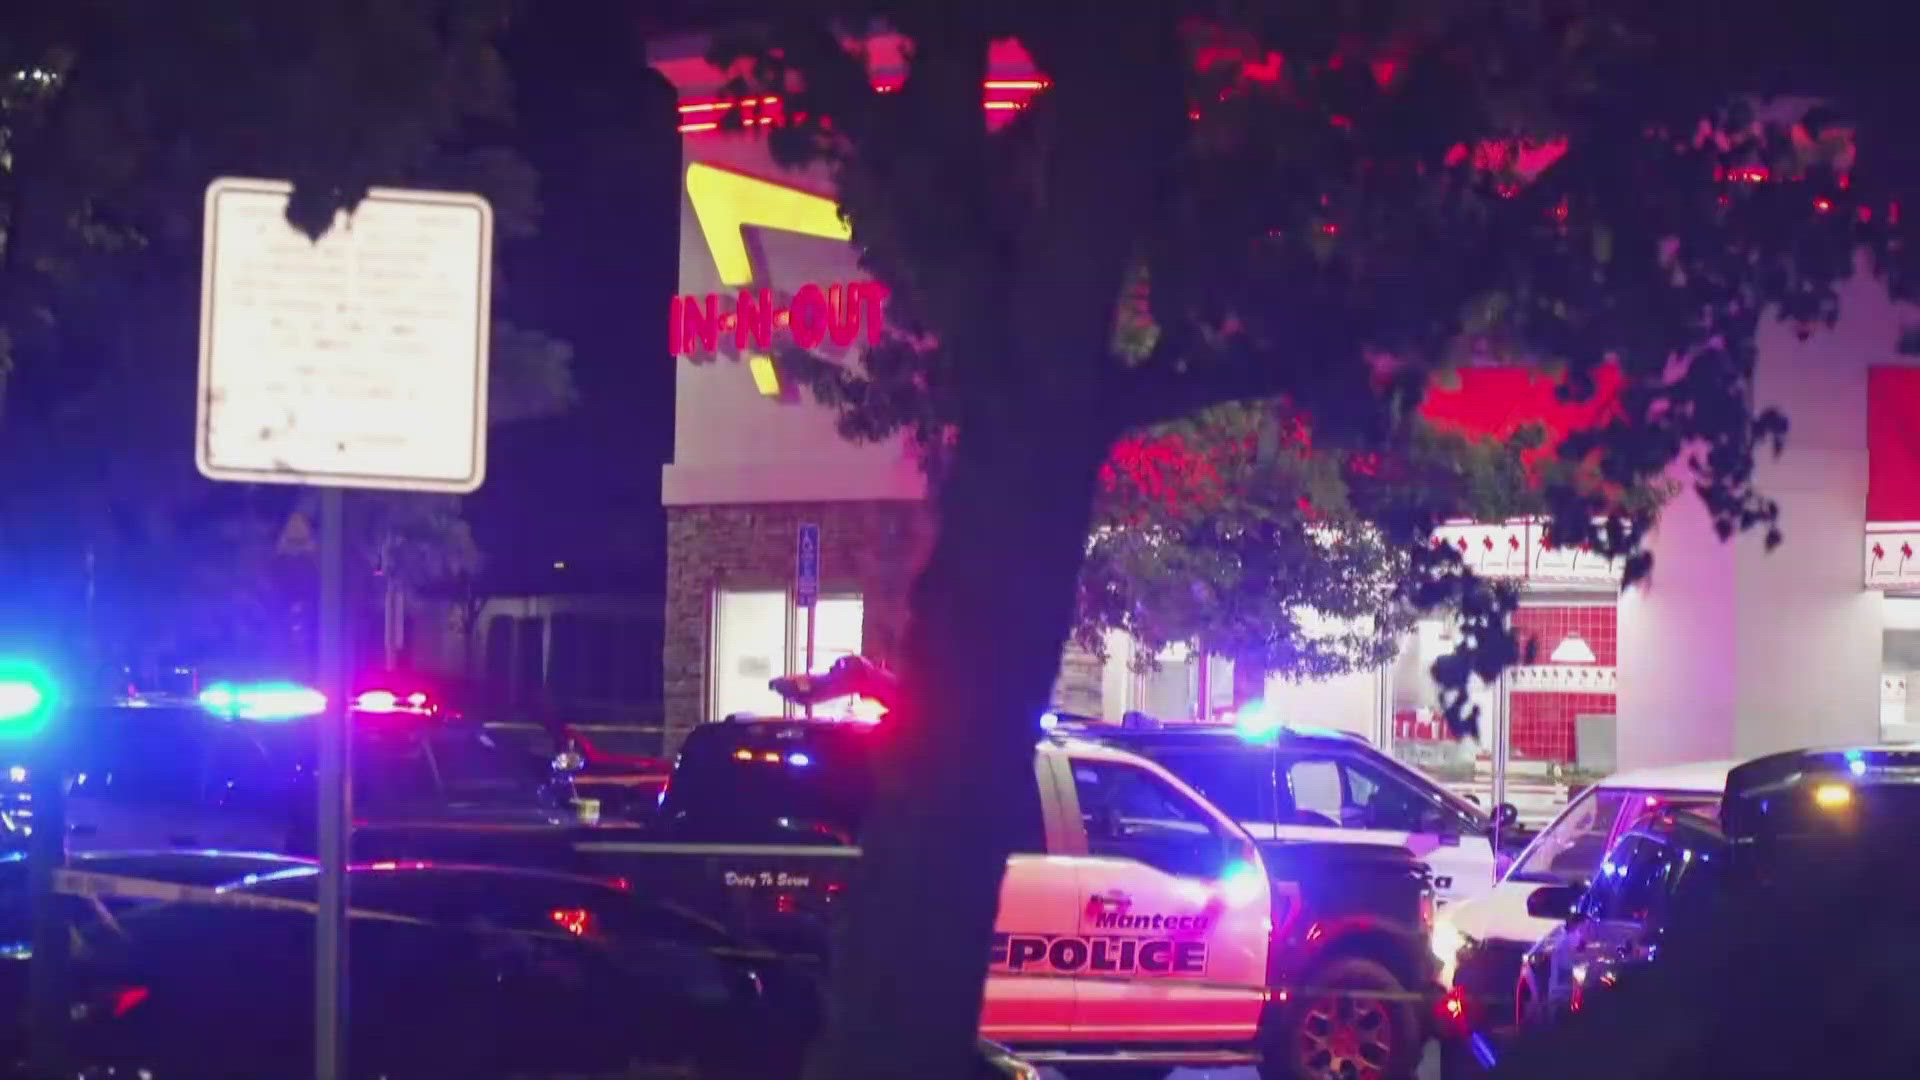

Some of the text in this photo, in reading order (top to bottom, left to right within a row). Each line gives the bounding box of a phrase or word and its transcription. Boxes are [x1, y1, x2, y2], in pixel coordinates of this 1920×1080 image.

[725, 871, 756, 888] Duty
[760, 871, 774, 886] To
[1095, 911, 1209, 930] Manteca
[1007, 936, 1208, 975] POLICE
